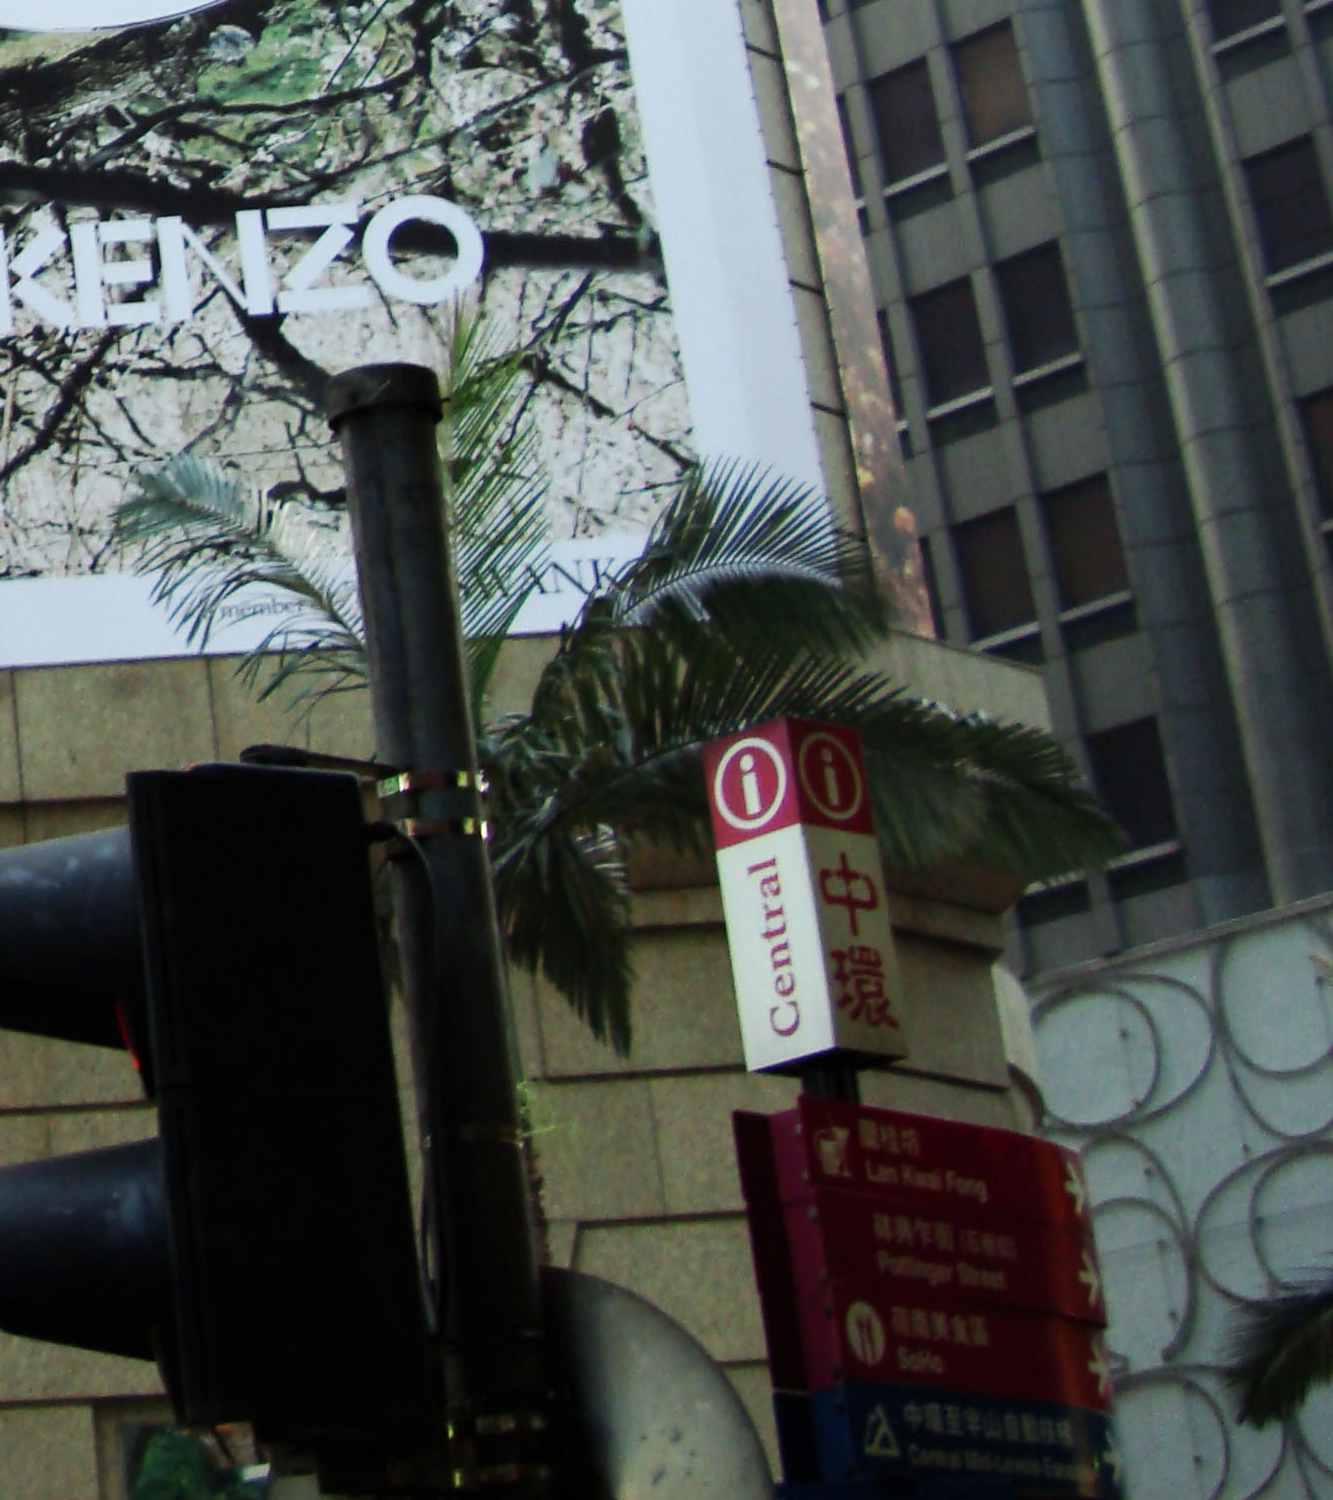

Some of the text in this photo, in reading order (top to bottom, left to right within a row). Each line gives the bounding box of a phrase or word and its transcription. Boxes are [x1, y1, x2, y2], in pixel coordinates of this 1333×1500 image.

[747, 856, 799, 1036] Central
[817, 851, 899, 1028] 中環
[865, 1158, 989, 1203] Lan Kwai Fong
[956, 1261, 1008, 1290] Street
